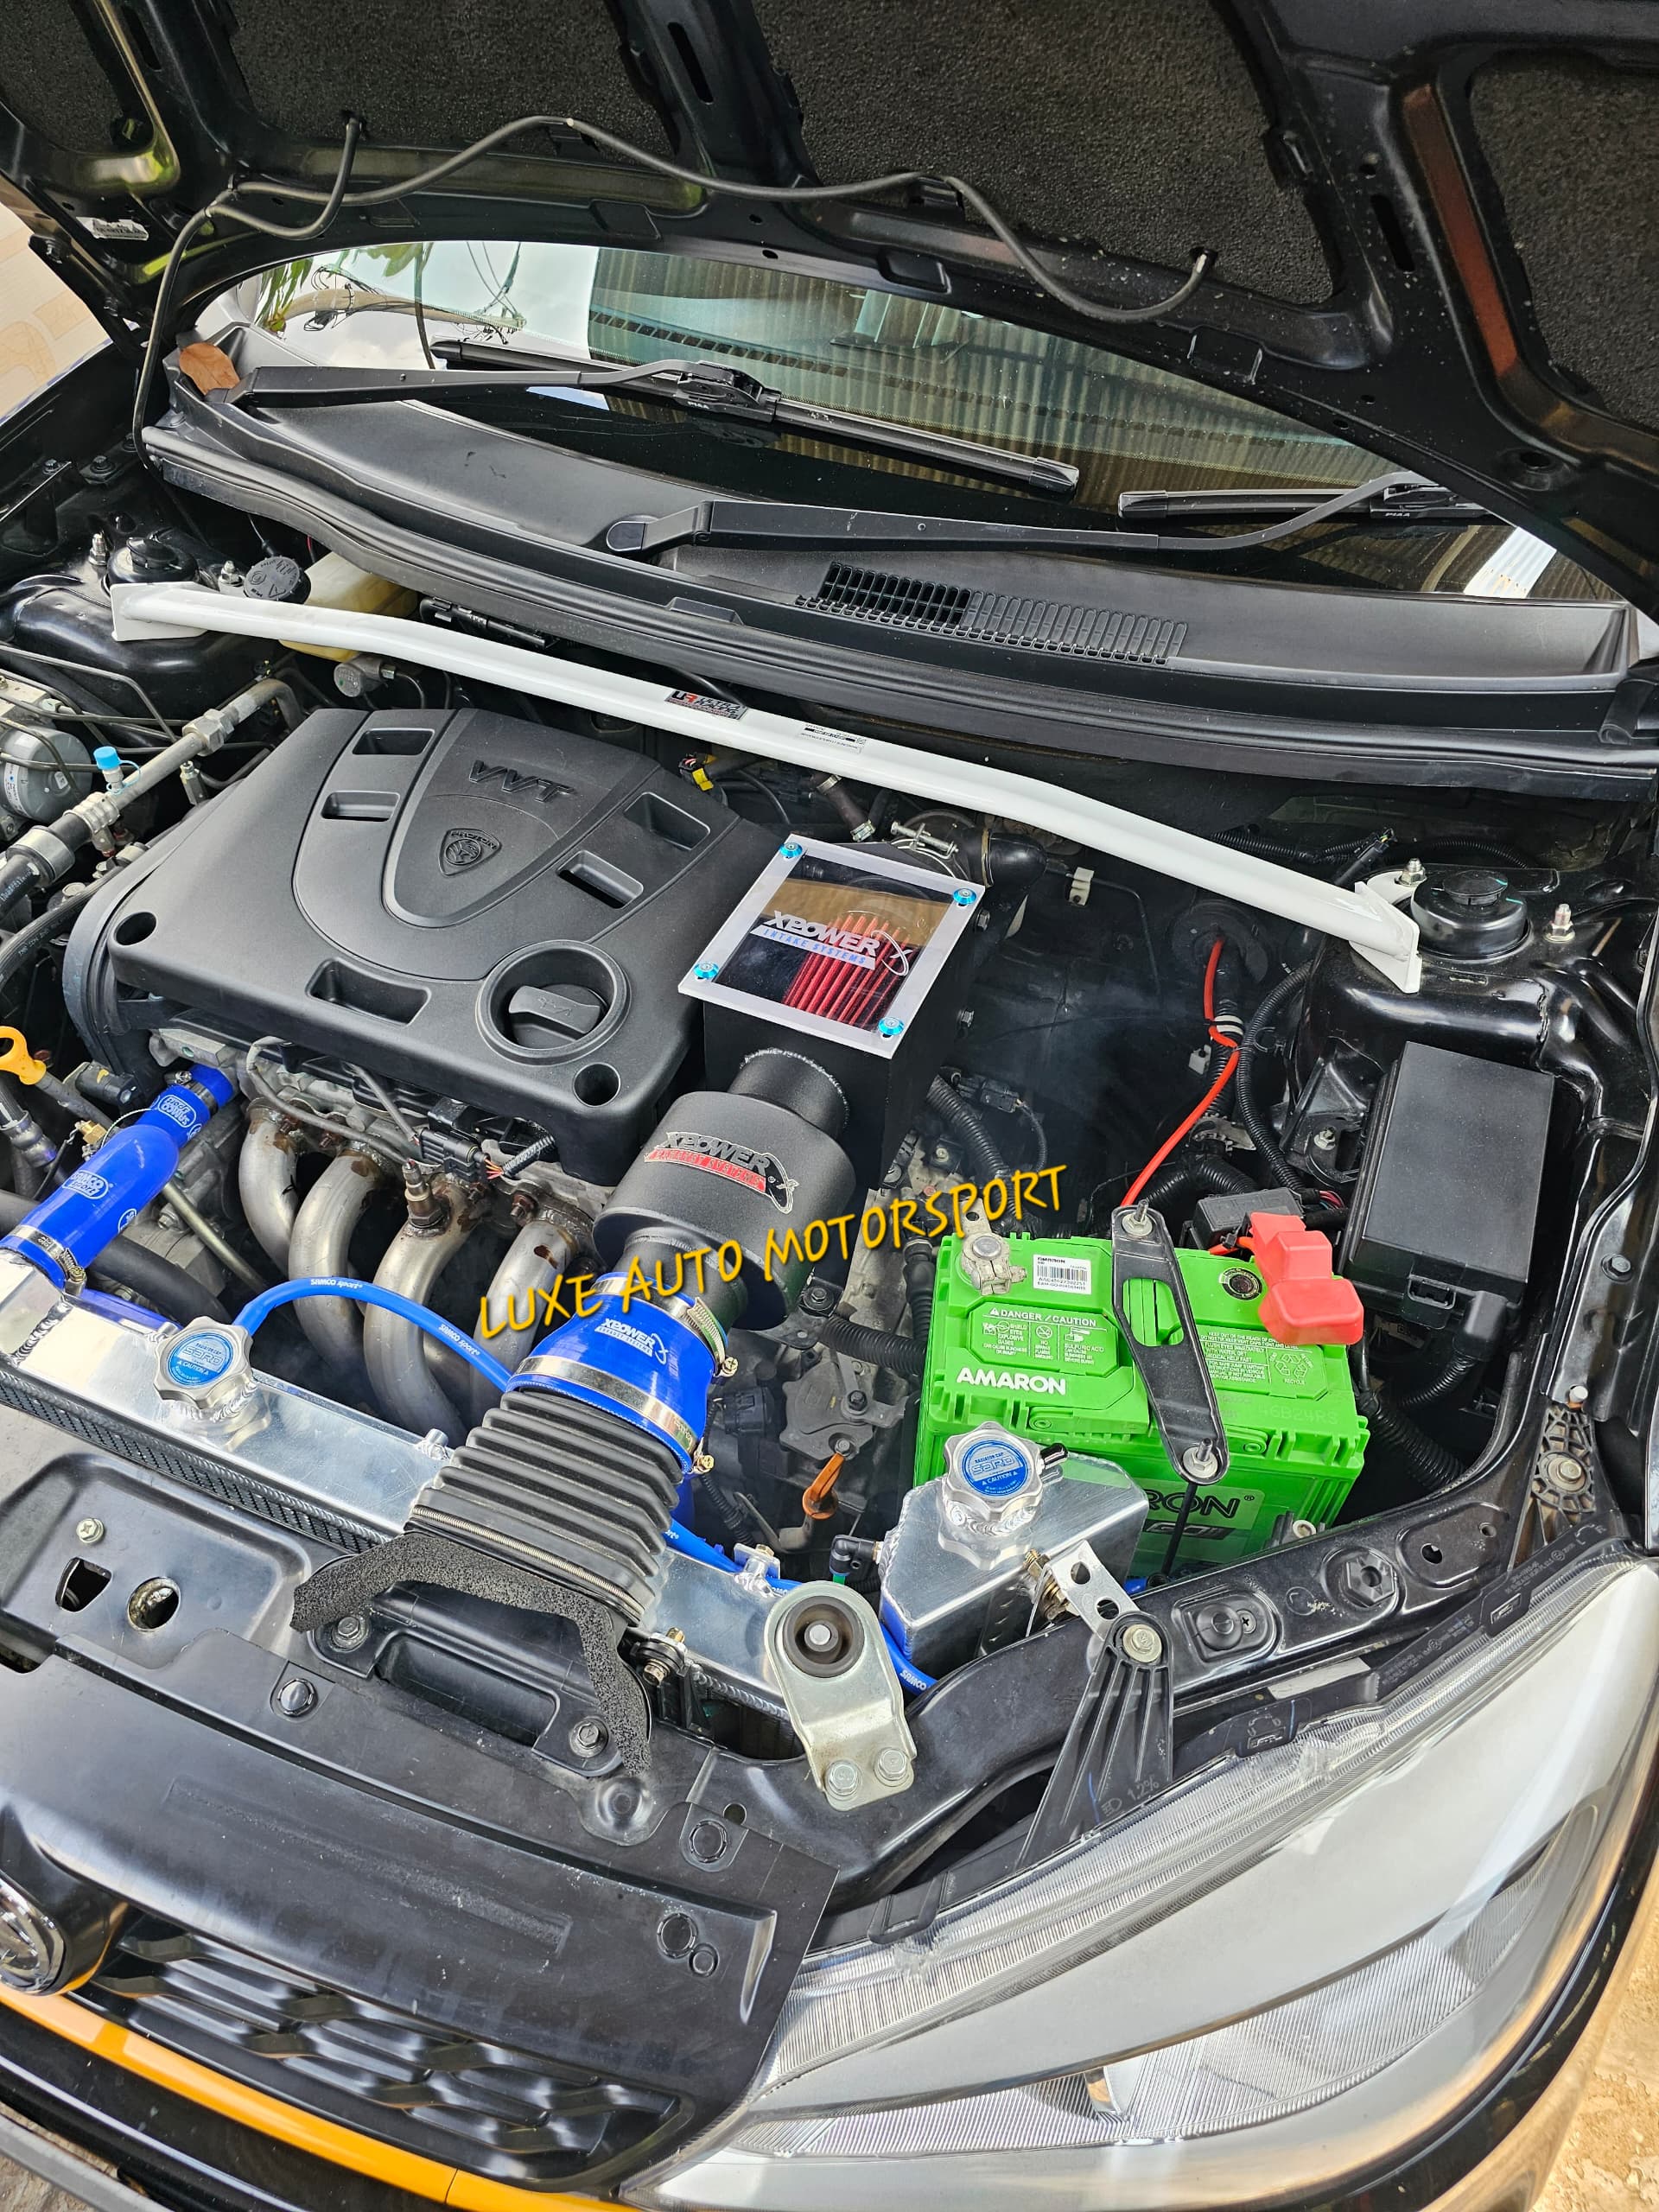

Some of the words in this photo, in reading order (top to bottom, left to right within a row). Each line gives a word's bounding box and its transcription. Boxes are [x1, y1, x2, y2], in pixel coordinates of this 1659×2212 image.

[468, 760, 576, 803] VVT
[451, 831, 497, 849] PROTON
[764, 928, 808, 948] INTAKE
[812, 943, 867, 965] SYSTEMS
[765, 910, 880, 957] XPOWER
[654, 1132, 771, 1177] XPOWER
[709, 1160, 764, 1188] SYSTEMS
[1001, 1309, 1042, 1320] DANGER
[601, 1318, 656, 1350] XPOWER
[956, 1367, 1066, 1395] AMARON
[987, 1471, 1012, 1484] CAUTION
[899, 1669, 927, 1691] SAMCO
